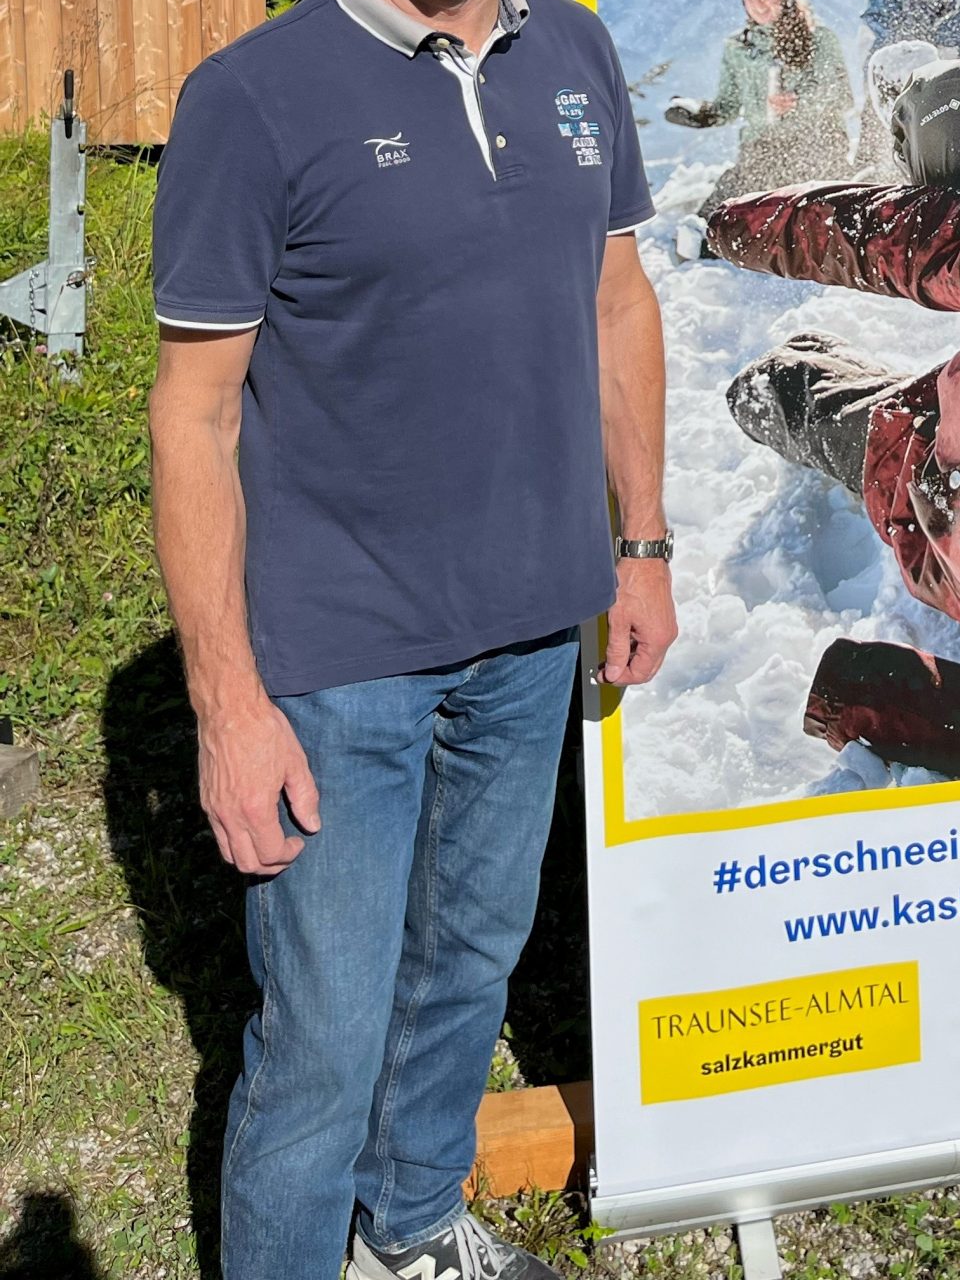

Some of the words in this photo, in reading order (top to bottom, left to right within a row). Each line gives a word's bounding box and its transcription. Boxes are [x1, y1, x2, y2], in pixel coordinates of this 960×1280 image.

[377, 149, 408, 163] BRAX
[651, 980, 910, 1041] TRAUNSEE-ALMTAL
[700, 1033, 864, 1077] salzkammergut
